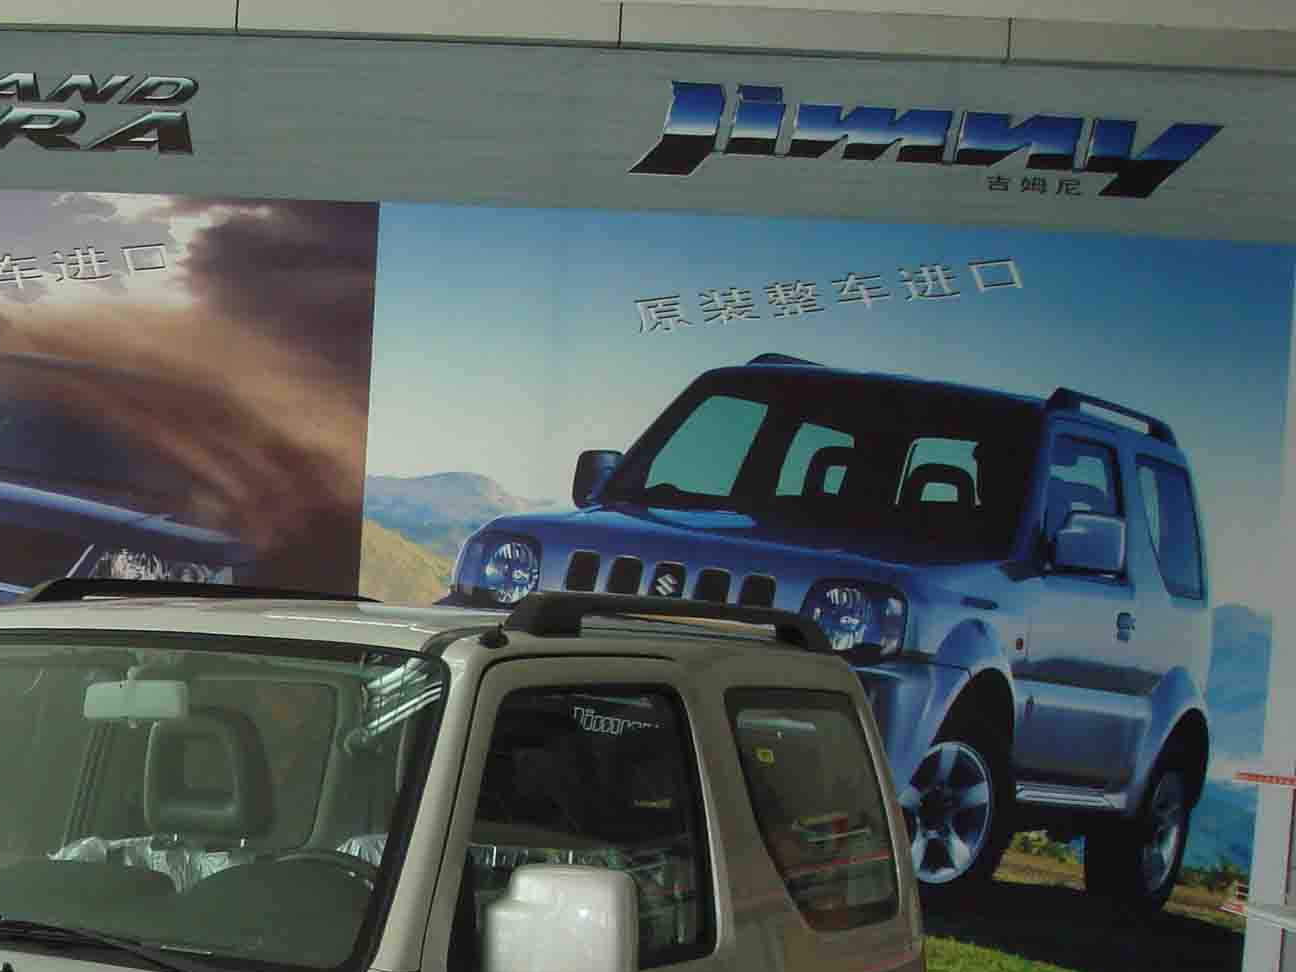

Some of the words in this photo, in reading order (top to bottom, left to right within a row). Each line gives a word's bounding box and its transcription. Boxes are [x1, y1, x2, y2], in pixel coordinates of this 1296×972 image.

[986, 175, 1085, 197] 吉姆尼
[633, 257, 1023, 335] 原装整车进口
